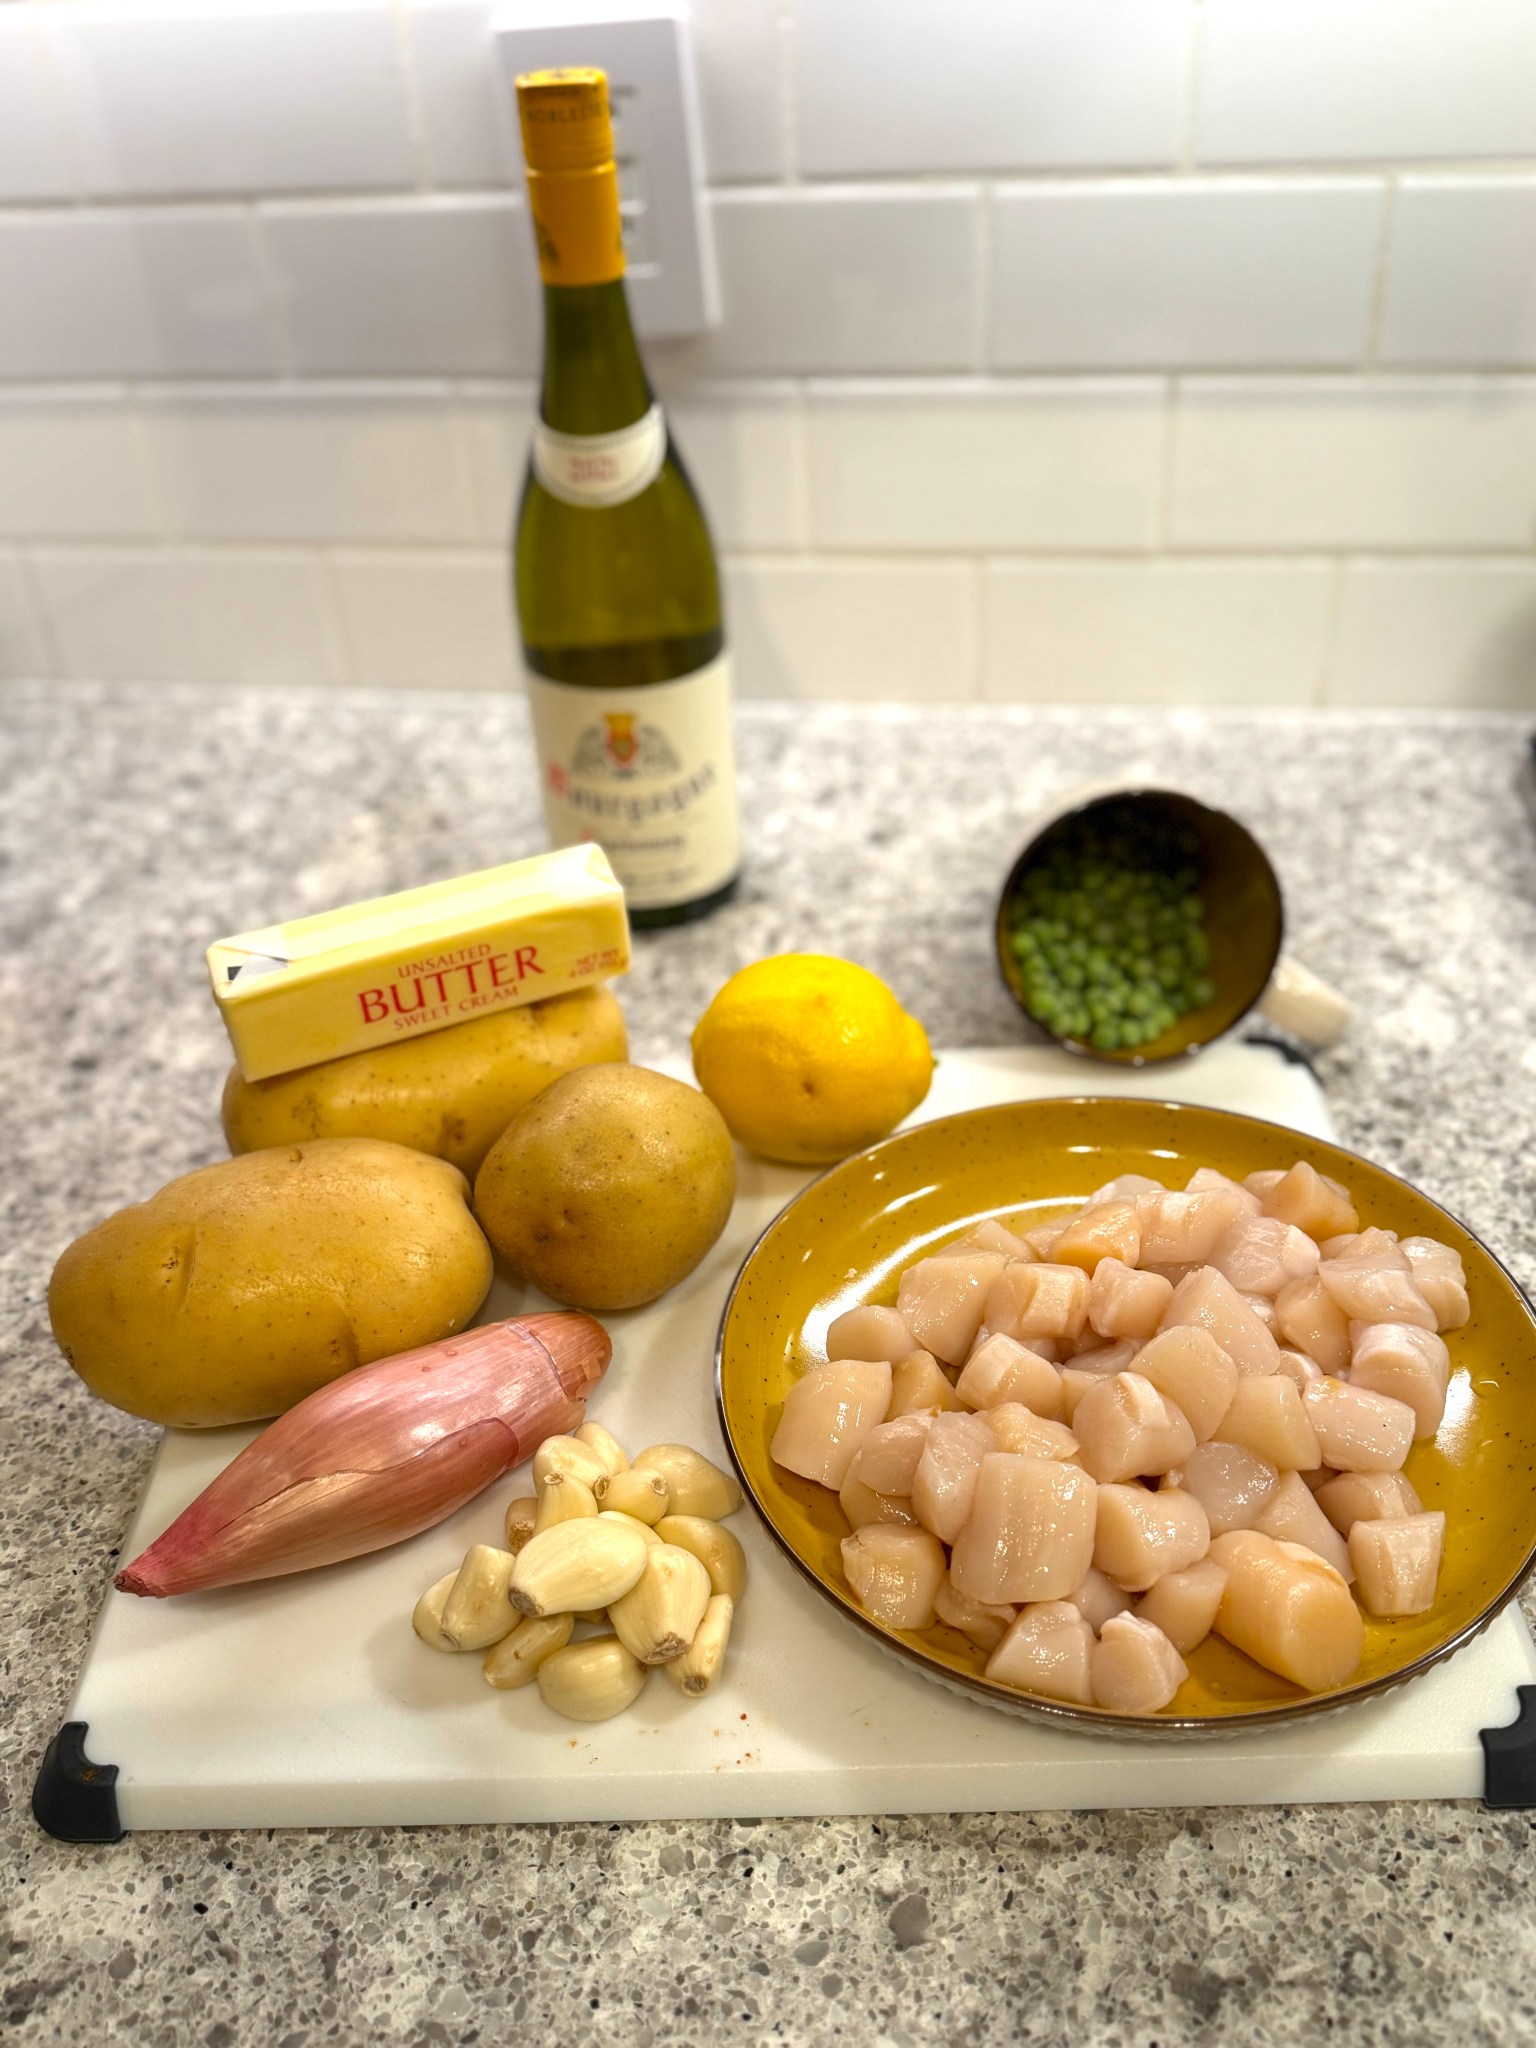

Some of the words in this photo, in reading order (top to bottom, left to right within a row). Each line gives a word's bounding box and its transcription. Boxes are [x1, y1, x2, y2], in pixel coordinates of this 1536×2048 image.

[397, 943, 492, 979] UNSALTED
[357, 945, 546, 1024] BUTTER
[394, 1004, 451, 1031] SWEET
[458, 985, 519, 1013] CREAM
